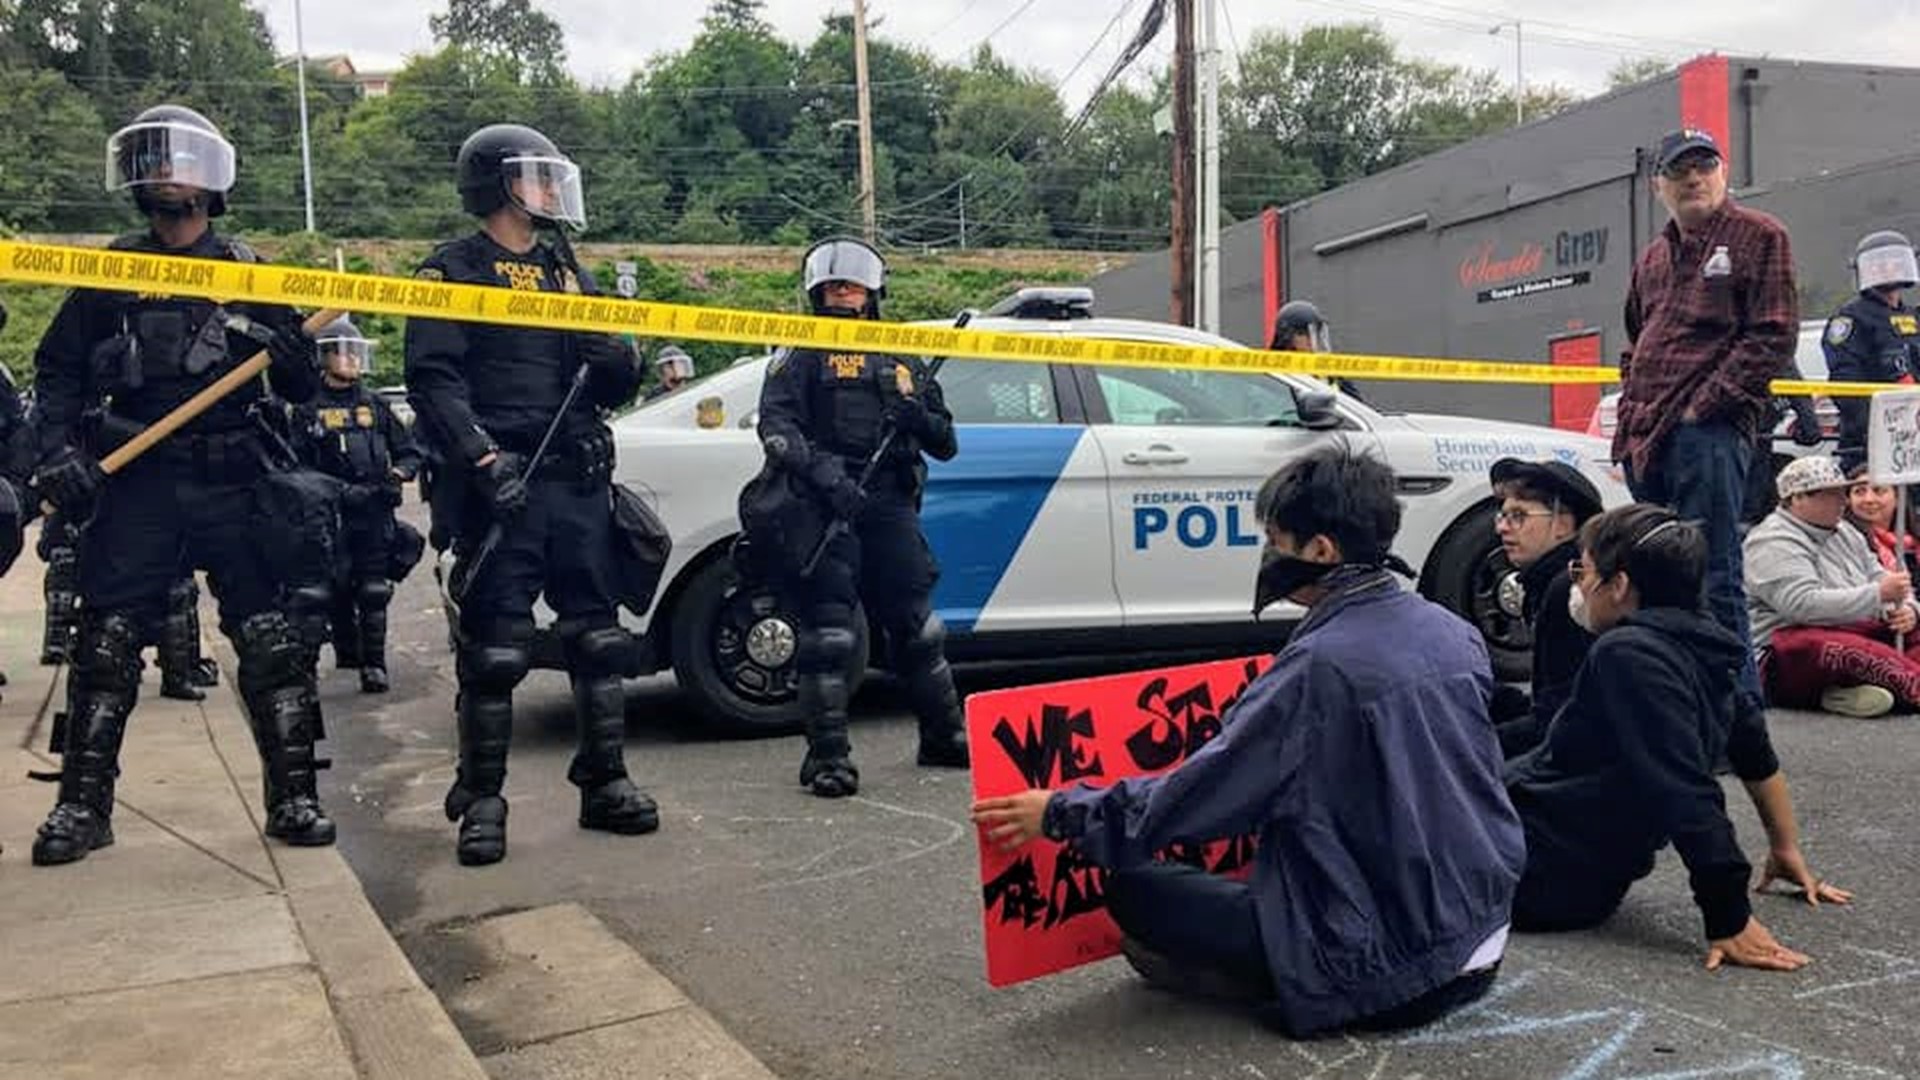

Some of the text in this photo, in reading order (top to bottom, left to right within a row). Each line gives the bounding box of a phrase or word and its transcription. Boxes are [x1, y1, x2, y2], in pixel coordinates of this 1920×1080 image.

[1556, 226, 1609, 267] Grey
[495, 262, 546, 280] POLICE
[828, 353, 866, 368] POLICE
[1435, 437, 1537, 456] Homeland
[1436, 454, 1492, 473] Secur
[1133, 490, 1256, 504] FEDERAL PROTE
[1133, 505, 1259, 549] POL
[992, 703, 1104, 789] WE
